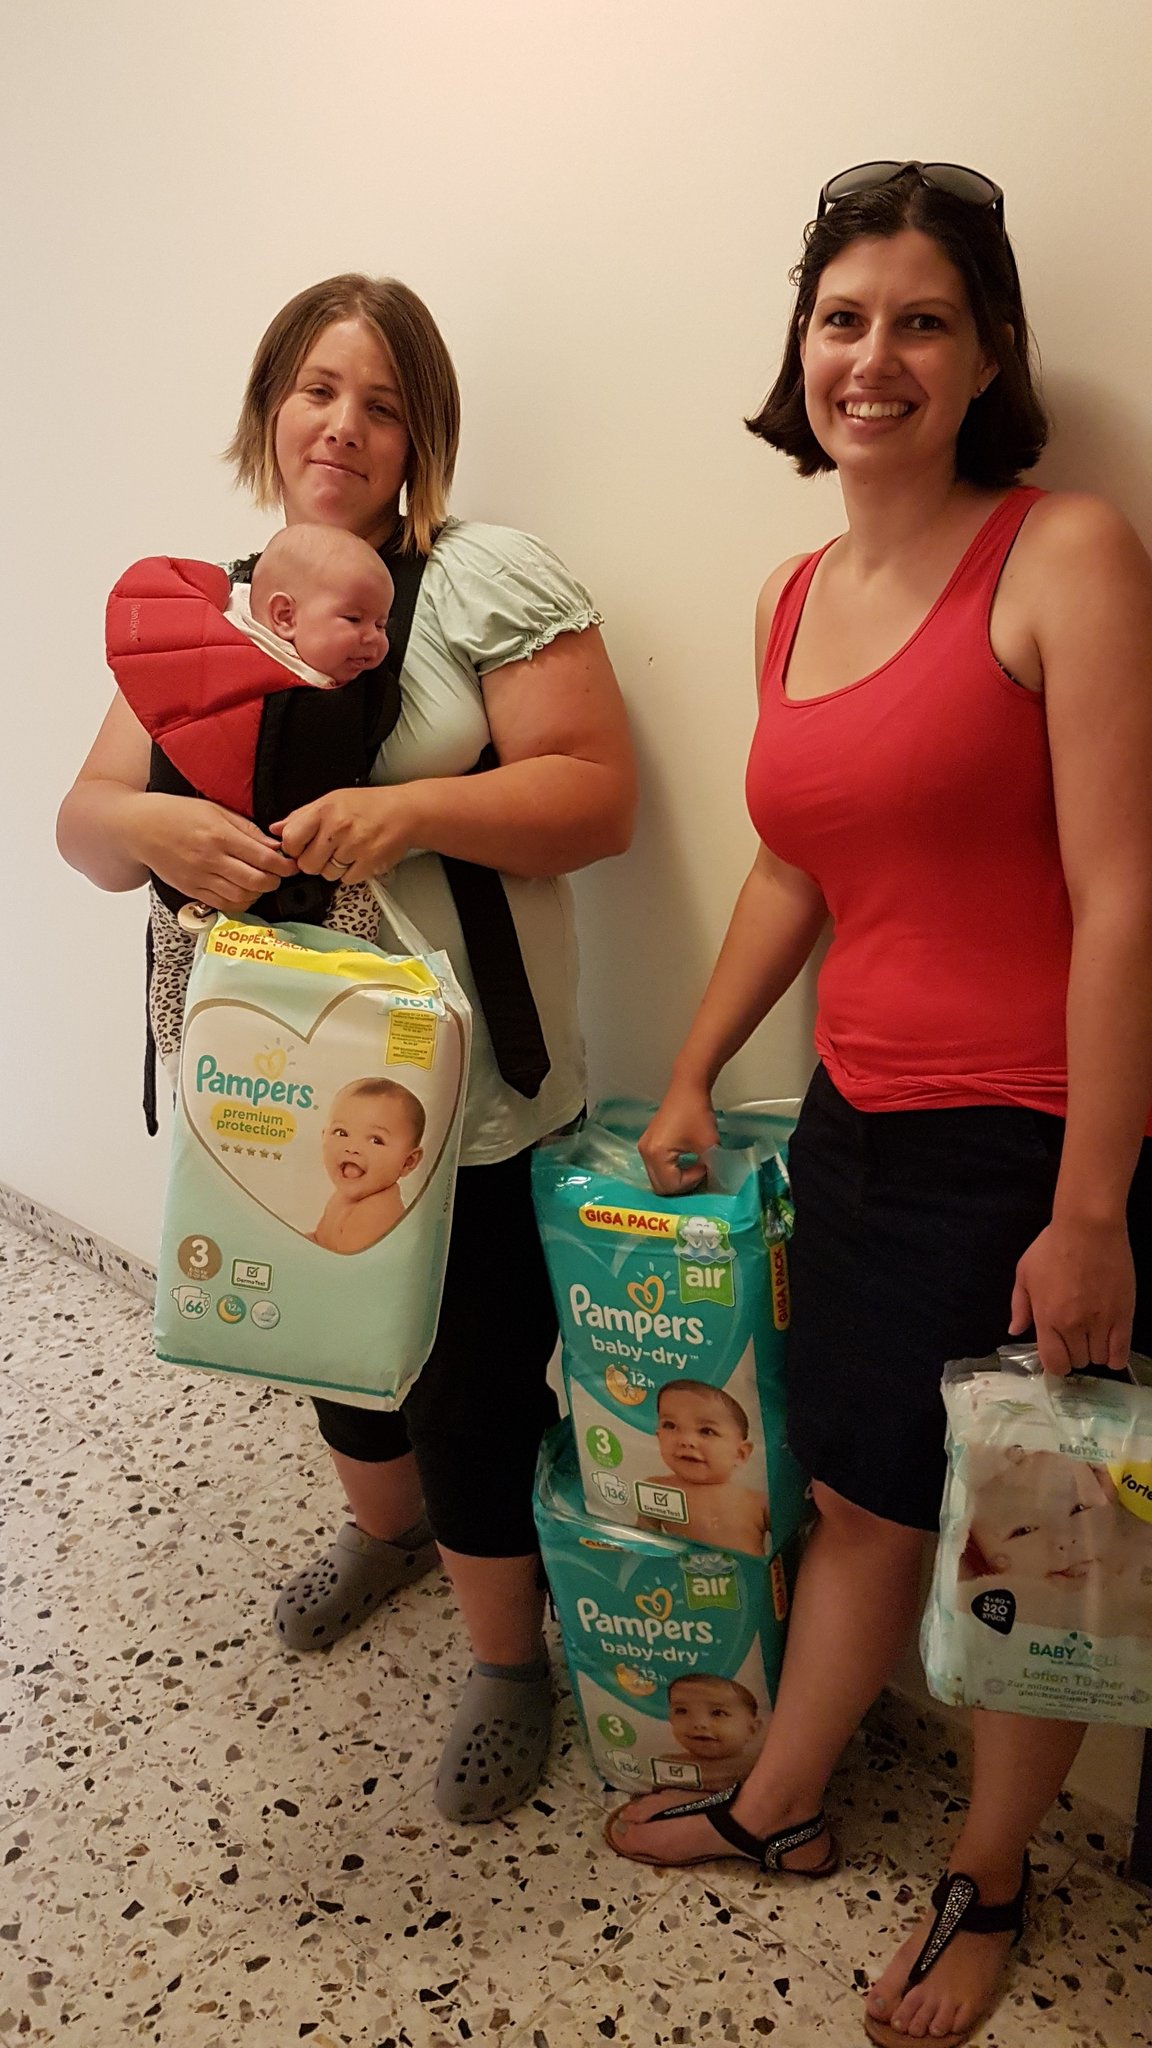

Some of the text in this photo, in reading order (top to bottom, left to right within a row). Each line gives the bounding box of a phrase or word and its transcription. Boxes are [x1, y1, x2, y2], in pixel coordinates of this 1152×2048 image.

[214, 941, 275, 962] BIG PACK
[196, 1054, 315, 1108] Pampers
[223, 1107, 283, 1126] premium
[584, 1208, 671, 1233] GIGA PACK
[189, 1239, 209, 1268] 3
[685, 1265, 726, 1289] air
[774, 1247, 785, 1287] PACK
[186, 1300, 204, 1314] 66
[569, 1283, 705, 1346] Pampers
[595, 1428, 612, 1455] 3
[606, 1485, 626, 1501] 136
[692, 1577, 731, 1597] air
[576, 1597, 714, 1645] Pampers
[982, 1602, 1009, 1616] 320
[608, 1715, 625, 1737] 3
